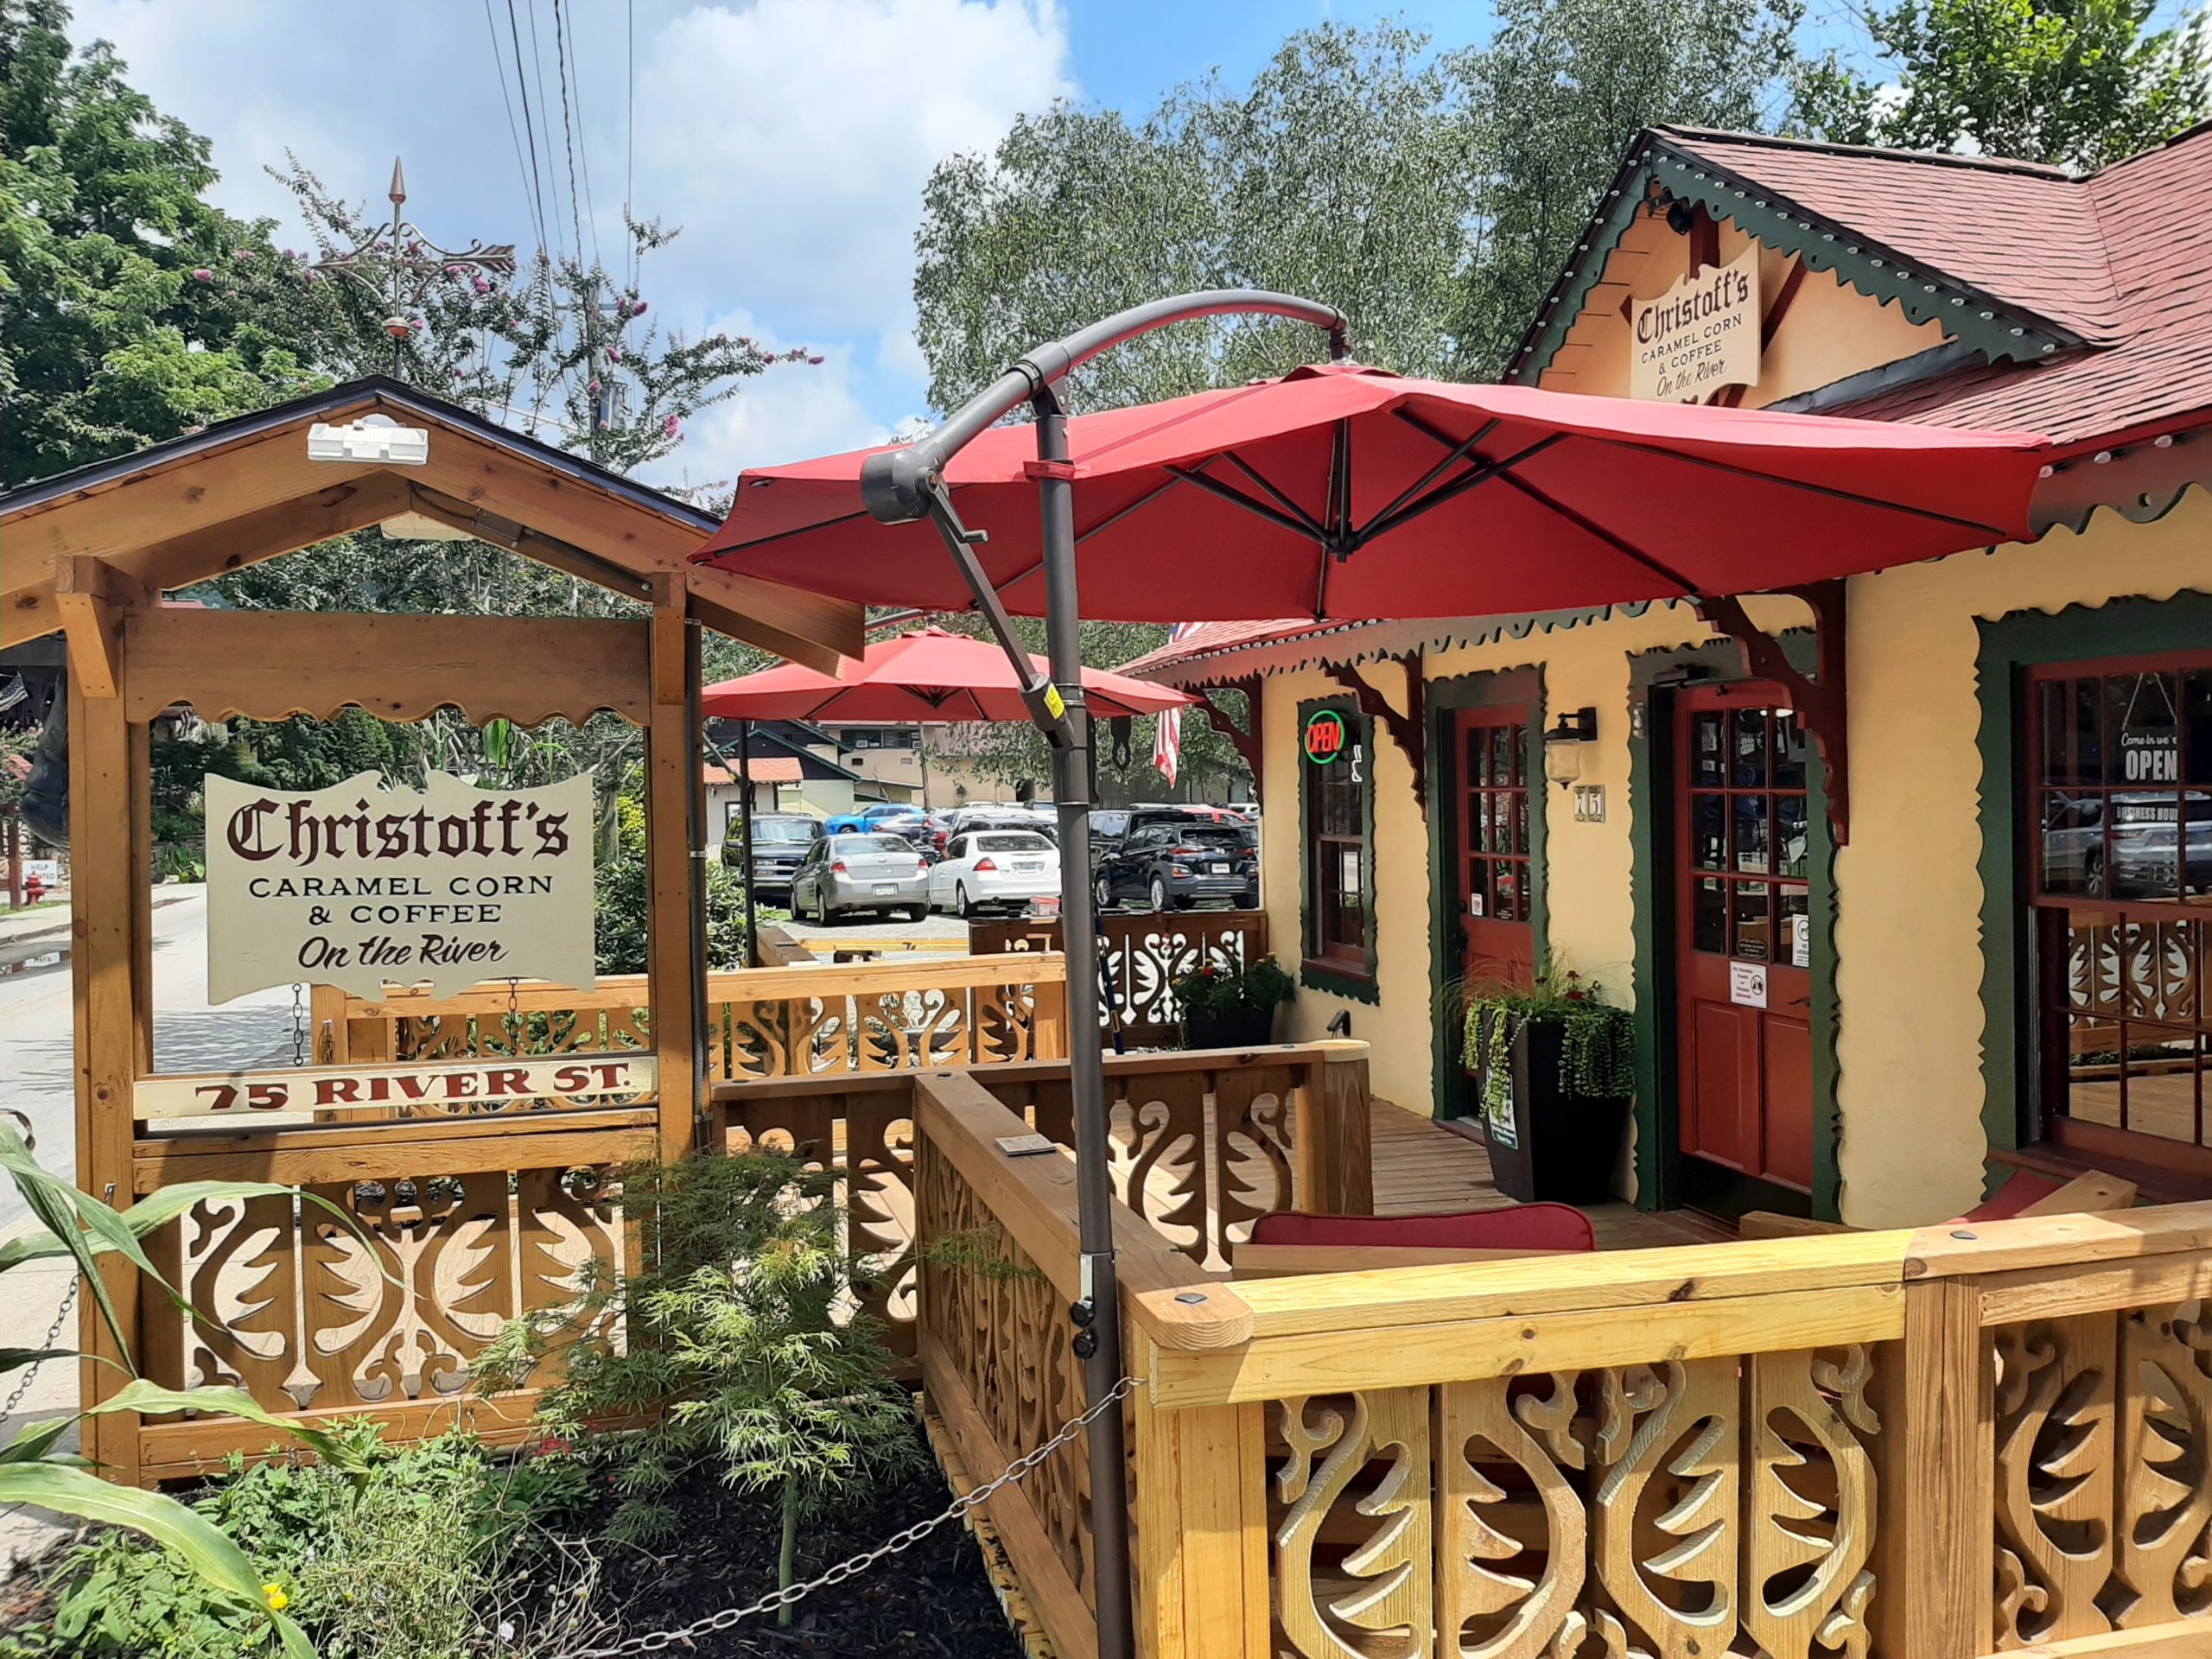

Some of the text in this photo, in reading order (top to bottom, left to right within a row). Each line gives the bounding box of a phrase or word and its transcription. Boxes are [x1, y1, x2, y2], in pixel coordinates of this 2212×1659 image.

[1637, 270, 1750, 344] Christoff's
[1642, 314, 1742, 364] CARAMEL CORN
[1659, 340, 1722, 375] & COFFEE
[1657, 359, 1727, 397] On the River
[1307, 721, 1341, 753] OPEN
[2121, 733, 2145, 747] Come
[2126, 750, 2177, 780] OPEN
[2117, 806, 2177, 821] BUSINESS HOU
[227, 798, 569, 867] Christoff's
[249, 874, 554, 898] CARAMEL CORN
[308, 904, 501, 925] & COFFEE
[298, 933, 510, 969] On the River
[195, 1062, 632, 1110] 75 RIVER ST.
